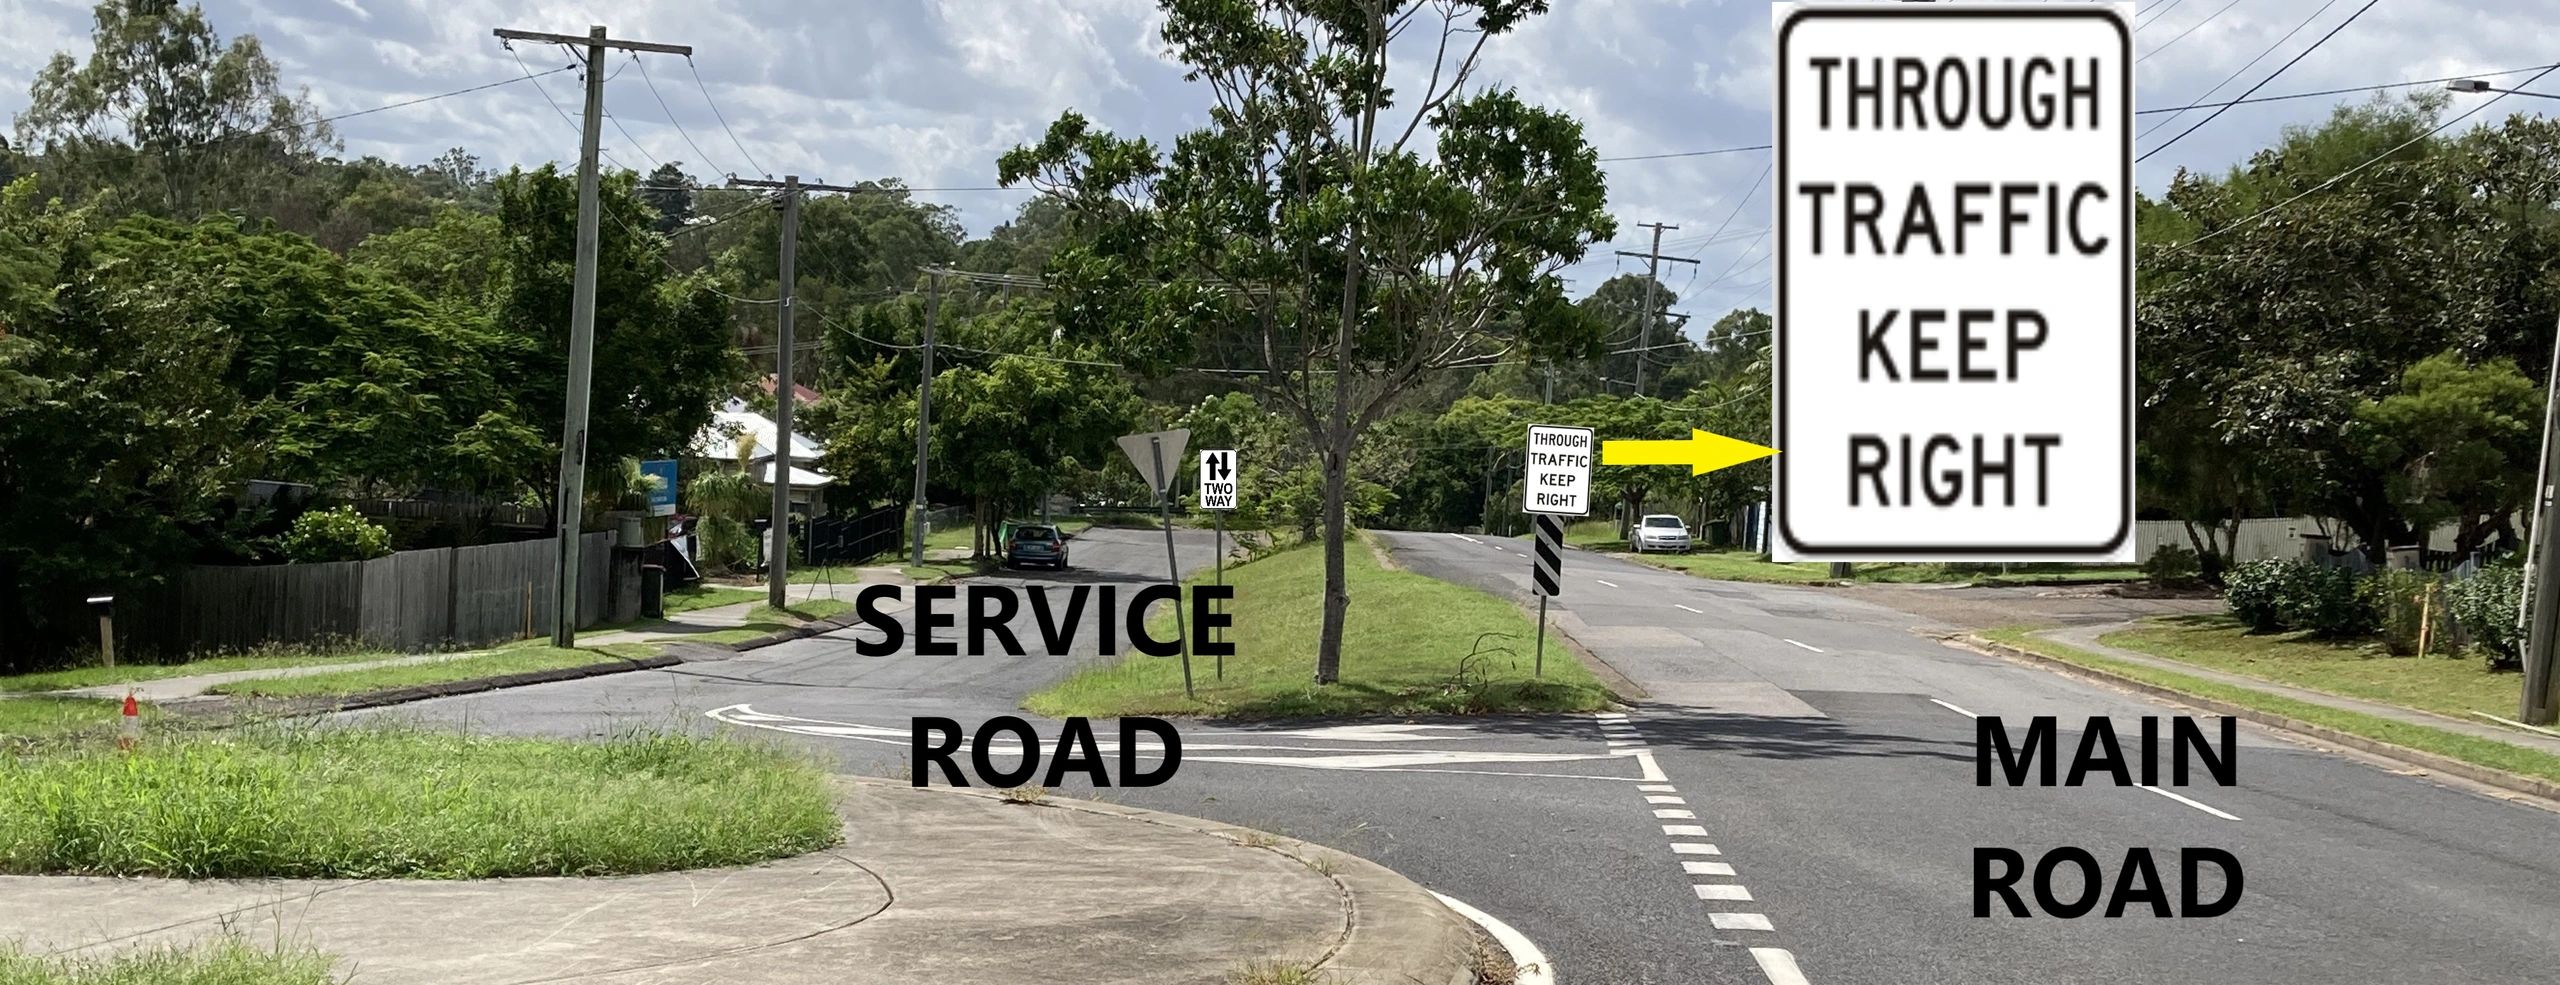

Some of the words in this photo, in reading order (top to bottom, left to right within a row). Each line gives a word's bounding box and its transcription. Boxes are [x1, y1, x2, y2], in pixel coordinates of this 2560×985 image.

[1534, 432, 1588, 447] THROUGH
[1531, 452, 1588, 468] TRAFFIC
[1540, 473, 1576, 487] KEEP
[1204, 483, 1233, 494] TWO
[1205, 495, 1232, 506] WAY
[1536, 492, 1577, 507] RIGHT
